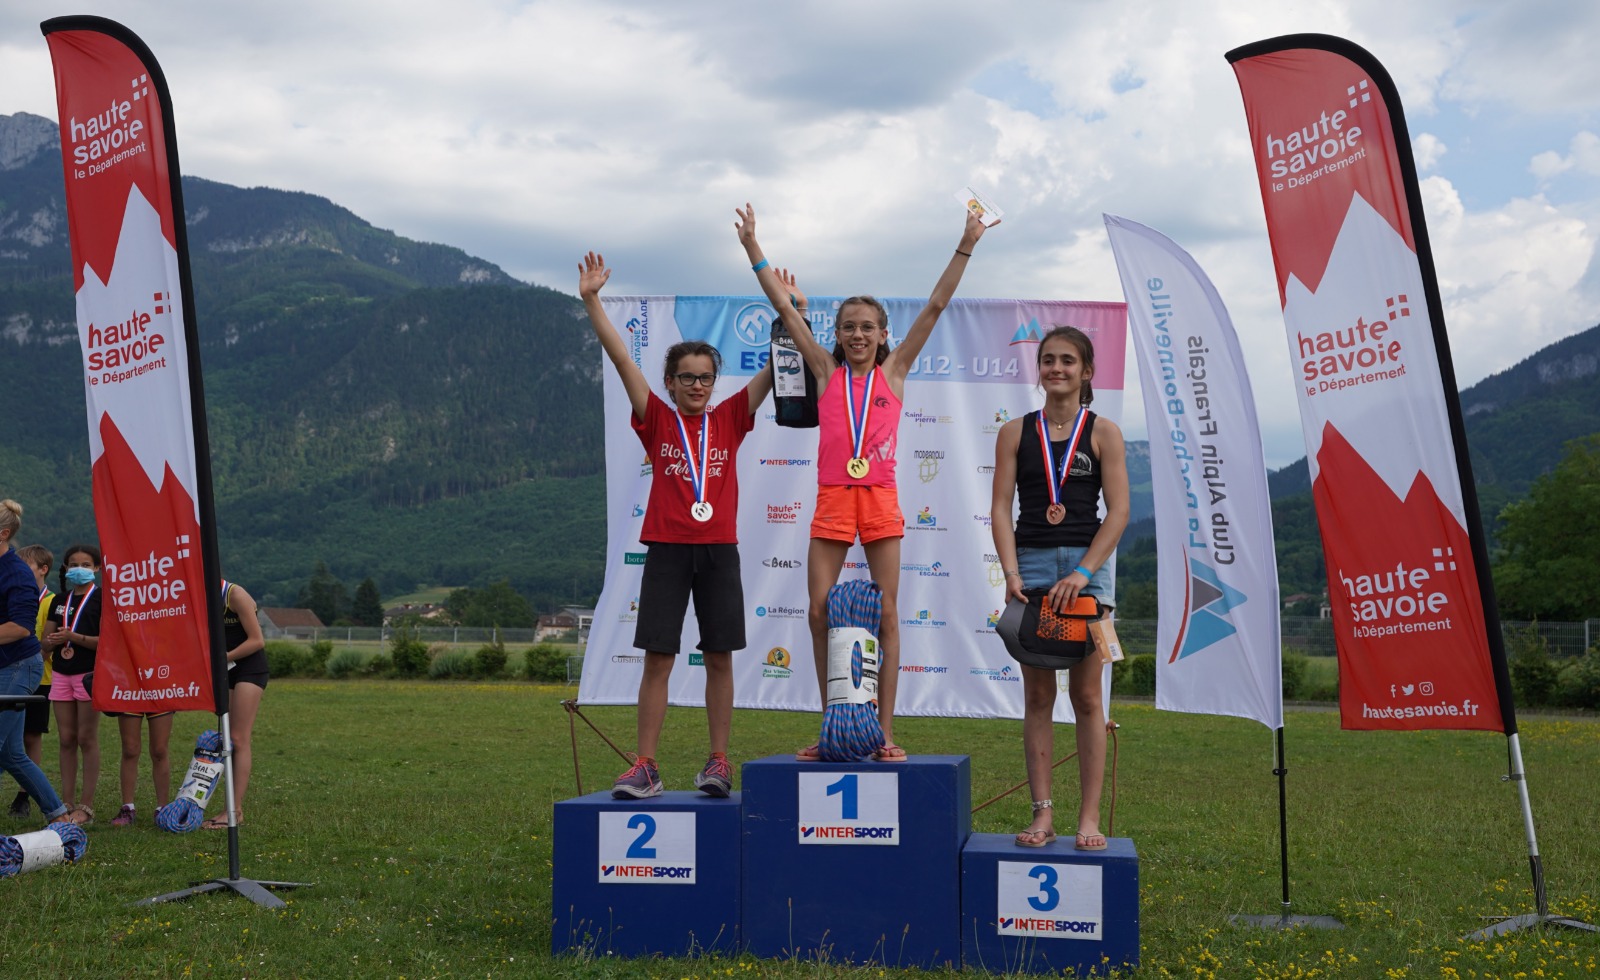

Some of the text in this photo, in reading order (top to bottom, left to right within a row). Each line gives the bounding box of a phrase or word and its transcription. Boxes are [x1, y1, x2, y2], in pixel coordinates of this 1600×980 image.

[70, 98, 131, 143] haute
[1266, 108, 1347, 159] haute
[73, 118, 144, 165] savoie
[1271, 125, 1362, 178] savoie
[74, 142, 147, 180] le Département
[1272, 147, 1367, 193] le Département
[88, 309, 151, 349] haute
[1297, 316, 1389, 359] haute
[88, 332, 165, 372] savoie
[973, 356, 1019, 377] U14
[1303, 340, 1402, 381] savoie
[88, 356, 166, 387] le Département
[1306, 363, 1407, 397] le Département
[766, 458, 811, 467] INTERSPORT
[767, 503, 793, 514] haute
[767, 512, 797, 520] savoie
[104, 550, 174, 584] haute
[1338, 561, 1430, 599] haute
[117, 603, 187, 624] Département
[768, 606, 805, 616] La Région
[1351, 590, 1449, 623] savoie
[1362, 617, 1452, 639] Département
[902, 665, 949, 674] INTERSPORT
[1362, 699, 1479, 719] hautesavoie.fr
[826, 774, 859, 820] 1
[625, 813, 657, 859] 2
[815, 826, 894, 839] INTERSPORT
[615, 865, 692, 879] INTERSPORT
[1027, 865, 1060, 912] 3
[1014, 918, 1097, 934] INTERSPORT
